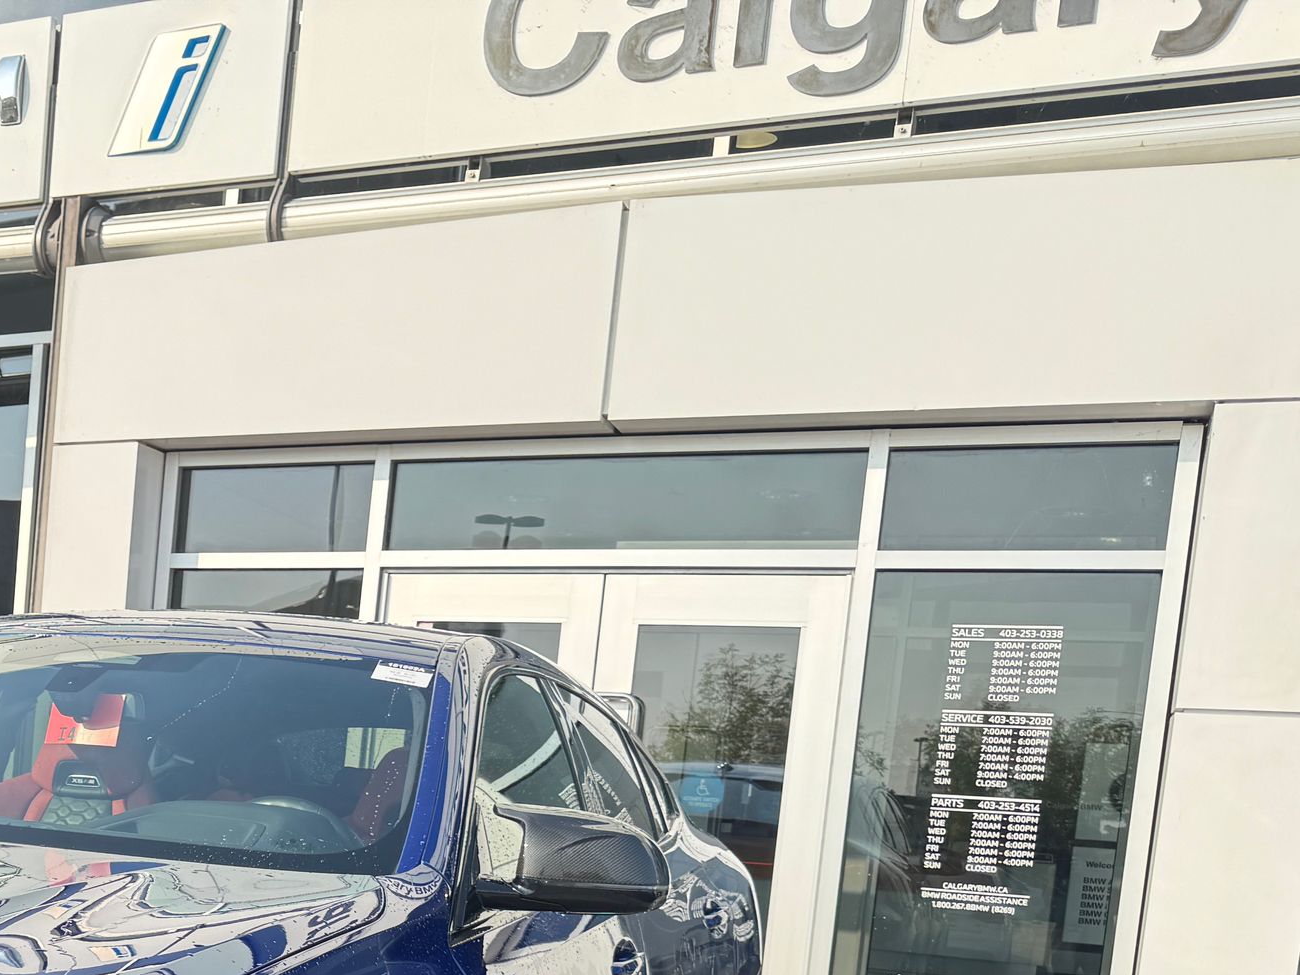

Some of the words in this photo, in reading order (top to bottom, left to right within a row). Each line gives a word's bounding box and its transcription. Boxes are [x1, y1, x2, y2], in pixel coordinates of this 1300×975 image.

[952, 629, 984, 637] SALES
[999, 630, 1063, 638] 403-253-0338
[989, 685, 1019, 693] 9:00AM
[988, 694, 1019, 702] CLOSED
[942, 714, 984, 723] SERVICE
[988, 715, 1052, 725] 403-539-2030
[983, 728, 1012, 736] 7:00AM
[1018, 738, 1048, 746] 6:00PM
[981, 745, 1010, 753] 7:00AM
[1017, 747, 1047, 755] 6:00PM
[1016, 756, 1046, 764] 6:00PM
[979, 762, 1008, 770] 7:00AM
[977, 771, 1007, 779] 9:00AM
[1014, 773, 1044, 781] 4:00PM
[976, 780, 1007, 788] CLOSED
[932, 798, 964, 808] PARTS
[978, 801, 1040, 812] 403-253-4514
[973, 813, 1002, 821] 7:00AM
[1009, 815, 1039, 823] 6:00PM
[929, 819, 946, 827] TUE
[972, 822, 1001, 830] 7:00AM
[1008, 824, 1038, 832] 6:00PM
[971, 831, 1000, 839] 7:00AM
[1006, 833, 1036, 841] 6:00PM
[970, 839, 999, 847] 7:00AM
[1005, 841, 1035, 850] 6:00PM
[969, 847, 998, 856] 7:00AM
[1004, 850, 1034, 858] 6:00PM
[967, 856, 997, 864] 9:00AM
[1003, 859, 1033, 867] 4:00PM
[965, 864, 997, 873] CLOSED
[1083, 877, 1106, 885] BMW
[942, 882, 1008, 894] CALGARYBMW.CA
[1082, 885, 1106, 893] BMW
[921, 891, 941, 899] BMW
[941, 893, 979, 903] ROADSIDE
[979, 896, 1028, 906] ASSISTANCE
[1081, 893, 1105, 901] BMW
[1080, 901, 1103, 909] BMW
[991, 906, 1015, 915] (8269)
[1079, 909, 1102, 917] BMW
[1078, 917, 1101, 926] BMW
